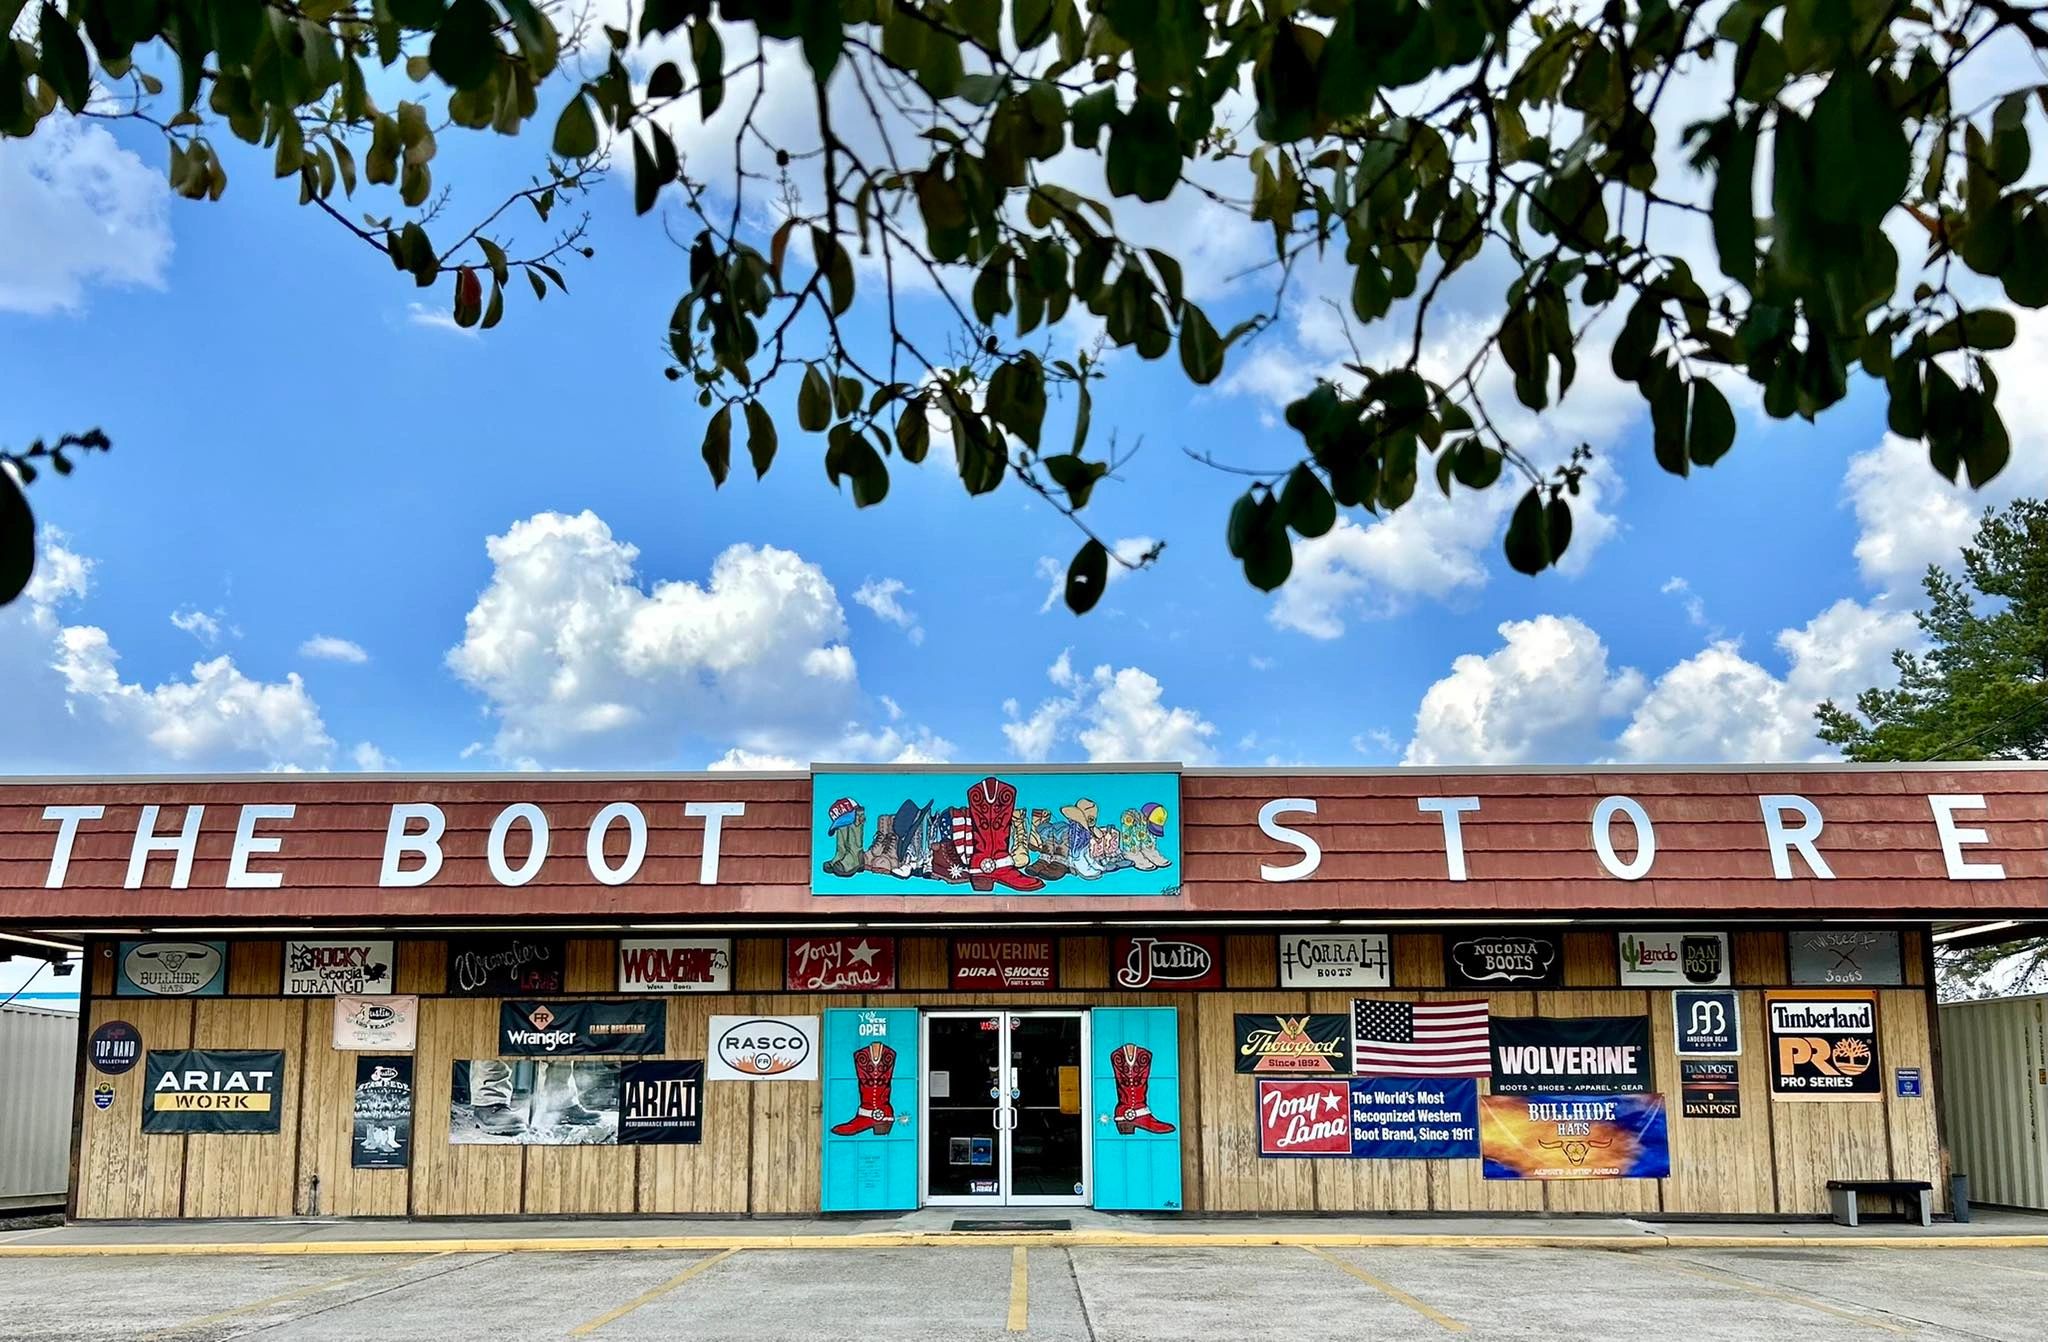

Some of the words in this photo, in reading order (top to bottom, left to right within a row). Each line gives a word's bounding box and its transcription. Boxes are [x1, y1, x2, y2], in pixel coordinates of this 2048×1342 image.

[42, 804, 296, 889] THE
[379, 801, 745, 888] BOOT
[1257, 794, 2006, 882] STORE
[314, 946, 371, 968] ROCKY
[795, 940, 842, 974] Tony
[957, 943, 1049, 960] WOLVERINE
[1297, 938, 1373, 969] CORRAL
[1474, 943, 1538, 956] NOCONA
[1639, 941, 1678, 965] Laredo
[1687, 945, 1716, 959] DAN
[622, 948, 717, 983] WOLVERINE
[1117, 937, 1206, 988] Justin
[1485, 955, 1533, 970] BOOTS
[1685, 959, 1719, 974] POST
[140, 971, 200, 985] BULLHIDE
[319, 967, 362, 979] Georgia
[807, 957, 880, 989] Lama
[957, 967, 997, 977] DURA
[1004, 966, 1049, 977] SHOCKS
[1317, 967, 1352, 977] BOOTS
[160, 984, 184, 992] HATS
[291, 980, 363, 993] DURANGO
[534, 1012, 549, 1023] FR
[1773, 1006, 1870, 1029] Timberland
[859, 1023, 886, 1036] OPEN
[507, 1030, 576, 1050] Wrangler
[725, 1037, 803, 1050] RASCO
[1241, 1029, 1343, 1057] Thorogood
[96, 1041, 111, 1057] TOP
[113, 1041, 135, 1057] HAND
[1268, 1058, 1295, 1067] Since
[1297, 1058, 1320, 1067] 1892
[1499, 1046, 1638, 1075] WOLVERINE
[155, 1071, 273, 1091] ARIAT
[1780, 1076, 1805, 1088] PRO
[1809, 1076, 1854, 1088] SERIES
[176, 1095, 249, 1109] WORK
[626, 1079, 696, 1119] ARIAT
[1352, 1092, 1371, 1105] The
[1374, 1091, 1415, 1105] World's
[1422, 1092, 1445, 1105] Most
[1263, 1090, 1318, 1128] Tony
[1353, 1110, 1417, 1124] Recognized
[1418, 1110, 1462, 1123] Western
[1528, 1102, 1616, 1121] BULLHIDE
[1276, 1114, 1348, 1148] Lama
[1354, 1127, 1381, 1140] Boot
[1382, 1127, 1418, 1143] Brand,
[1419, 1127, 1449, 1141] Since
[1451, 1127, 1474, 1140] 1911
[1556, 1122, 1590, 1136] HATS
